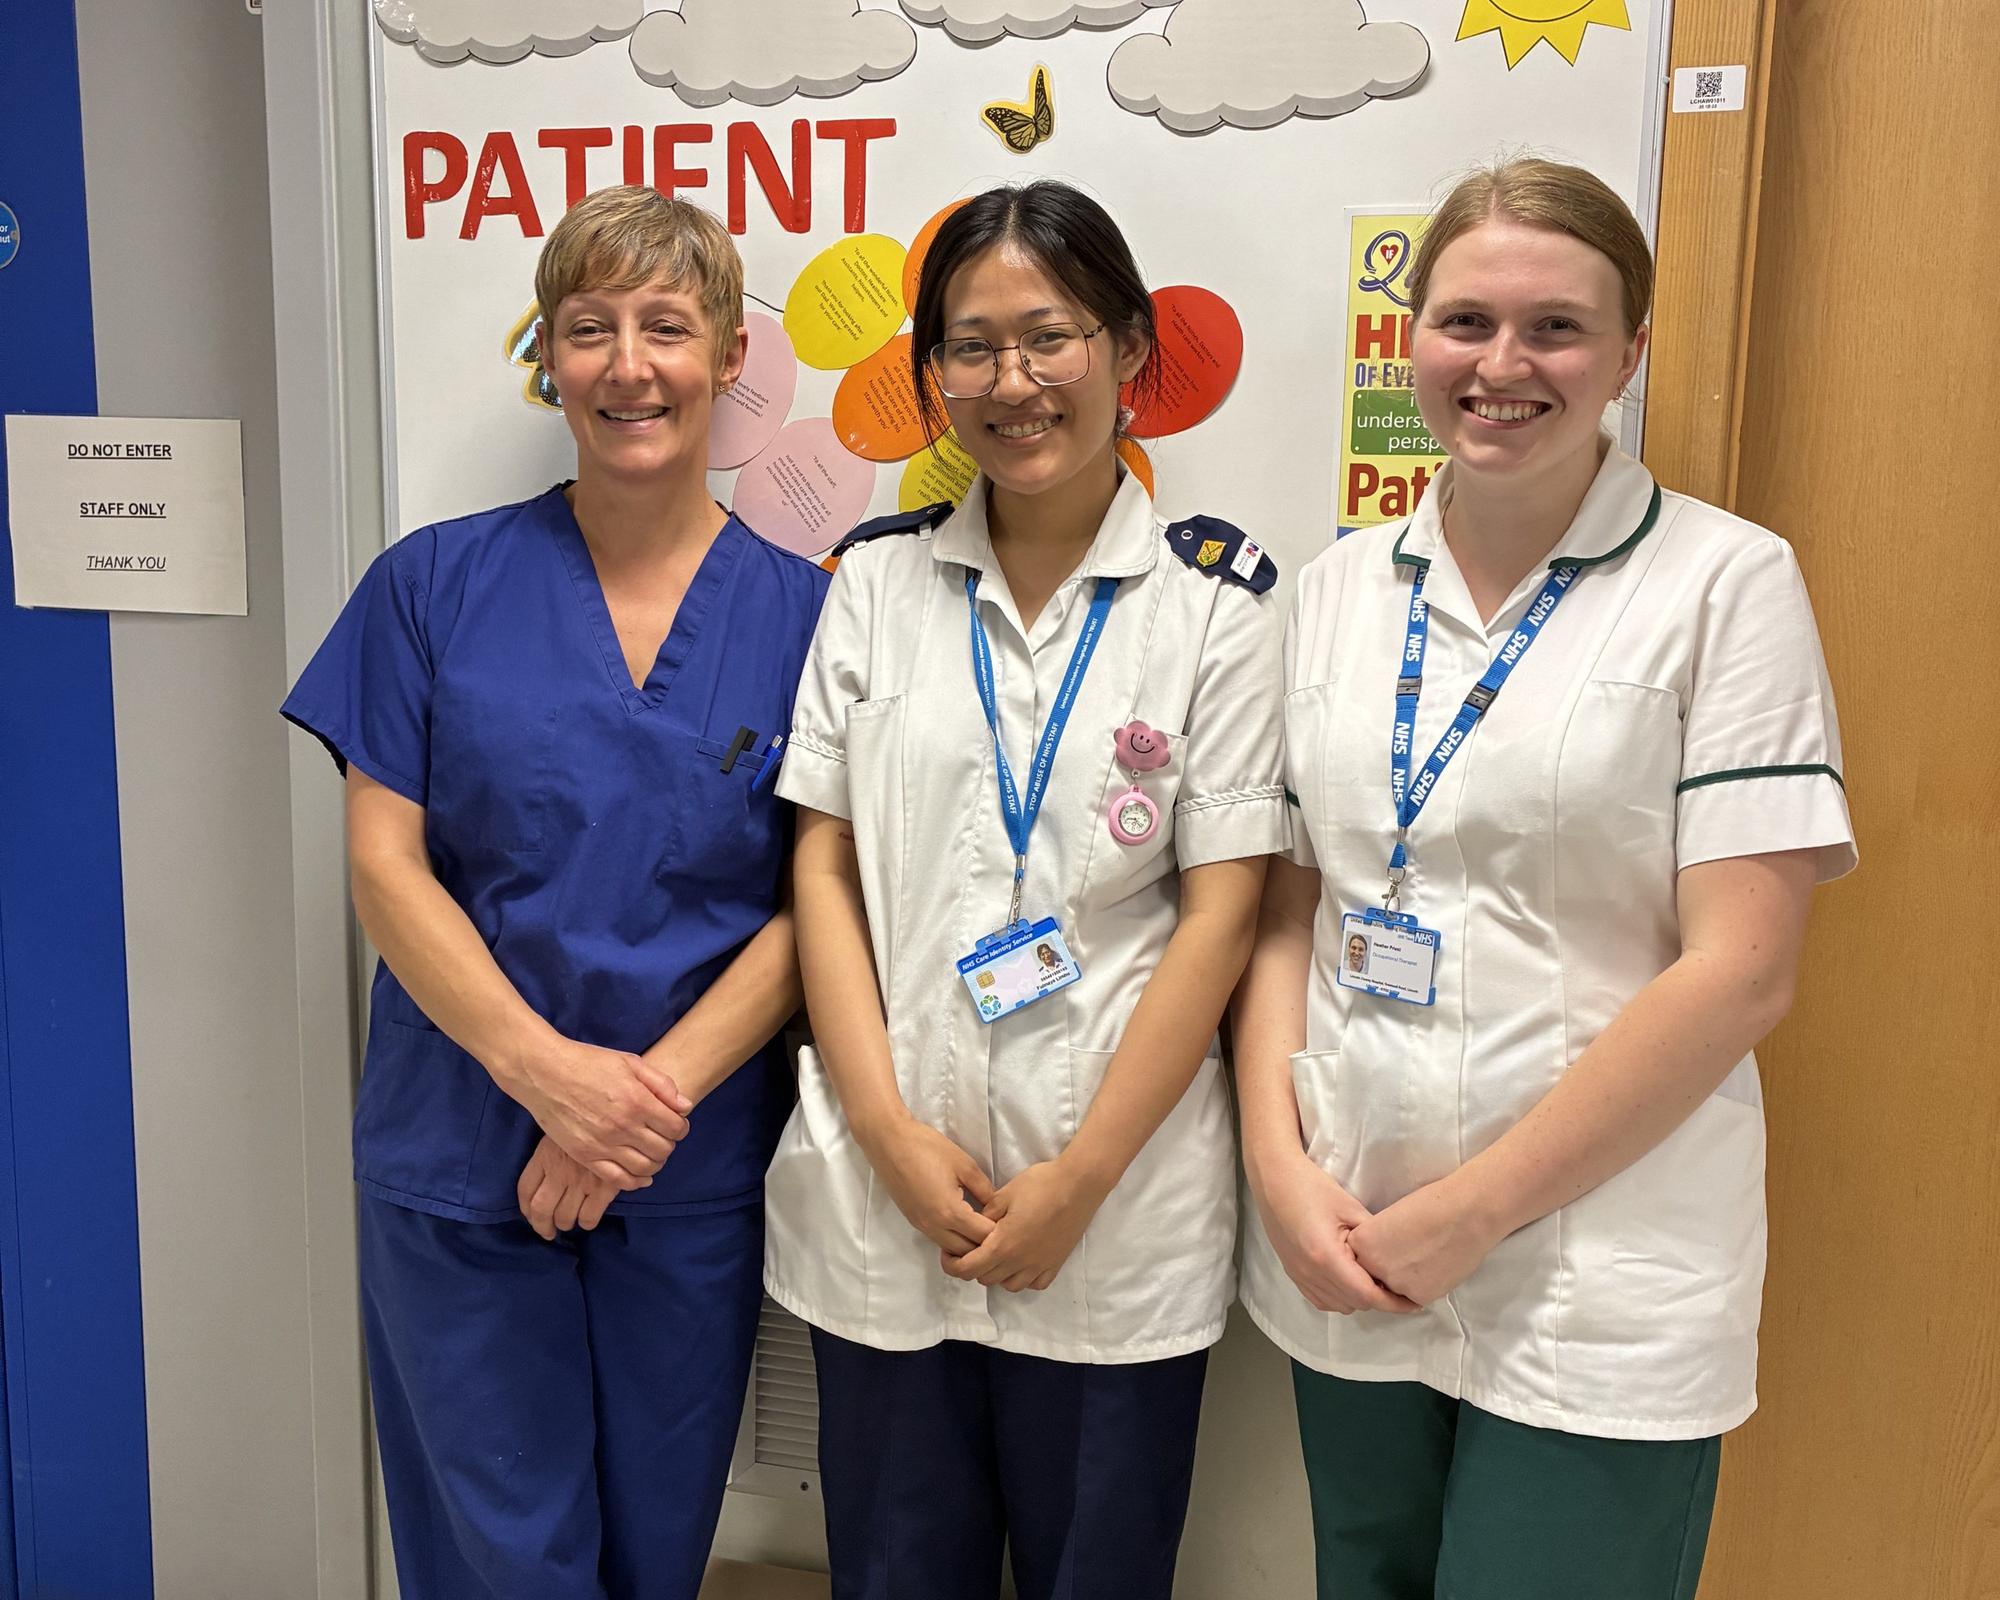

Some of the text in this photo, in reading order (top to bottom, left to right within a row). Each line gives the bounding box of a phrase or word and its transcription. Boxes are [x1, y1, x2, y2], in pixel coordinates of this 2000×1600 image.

[403, 118, 896, 240] PATIENT
[1355, 363, 1377, 387] OF
[68, 444, 172, 459] DO NOT ENTER
[1388, 436, 1440, 453] persp
[80, 502, 166, 517] STAFF ONLY
[87, 555, 166, 571] THANK YOU
[1392, 594, 1425, 802] NHS NHS NHS NHS
[1409, 769, 1436, 807] NHS
[1435, 727, 1463, 763] NHS
[1500, 630, 1529, 665] NHS
[1527, 591, 1555, 627] NHS
[1028, 722, 1059, 811] STOP ABUSE OF NHS STAFF
[1004, 778, 1012, 793] NHS
[1006, 794, 1018, 816] STAFF
[1414, 931, 1433, 946] NHS
[961, 932, 1033, 969] NHS Care Identity Service
